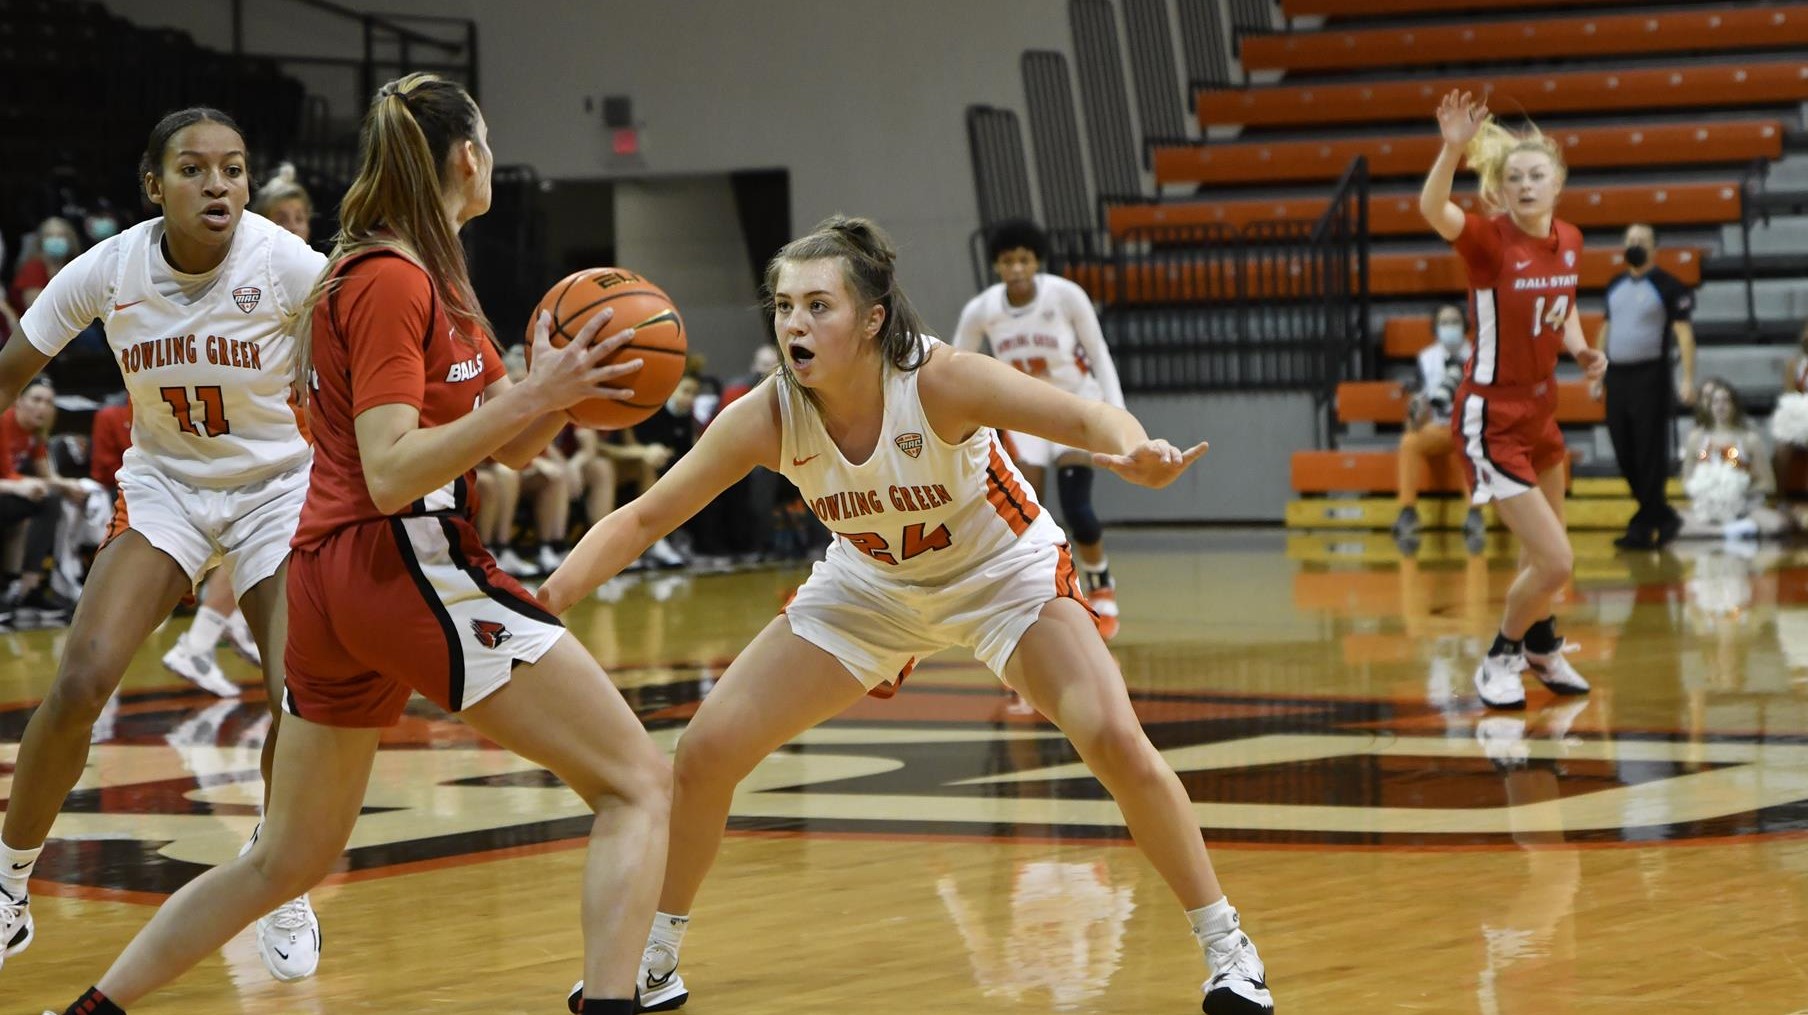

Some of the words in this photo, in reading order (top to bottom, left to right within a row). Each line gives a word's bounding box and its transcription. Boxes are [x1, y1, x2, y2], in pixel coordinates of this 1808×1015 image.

[235, 294, 260, 303] MAC
[1513, 277, 1547, 290] BALL
[1532, 294, 1569, 337] 14
[206, 335, 262, 371] GREEN
[445, 359, 479, 382] BALL
[160, 385, 231, 438] 11
[900, 439, 922, 450] MAC
[888, 483, 953, 513] GREEN
[834, 522, 953, 566] 24
